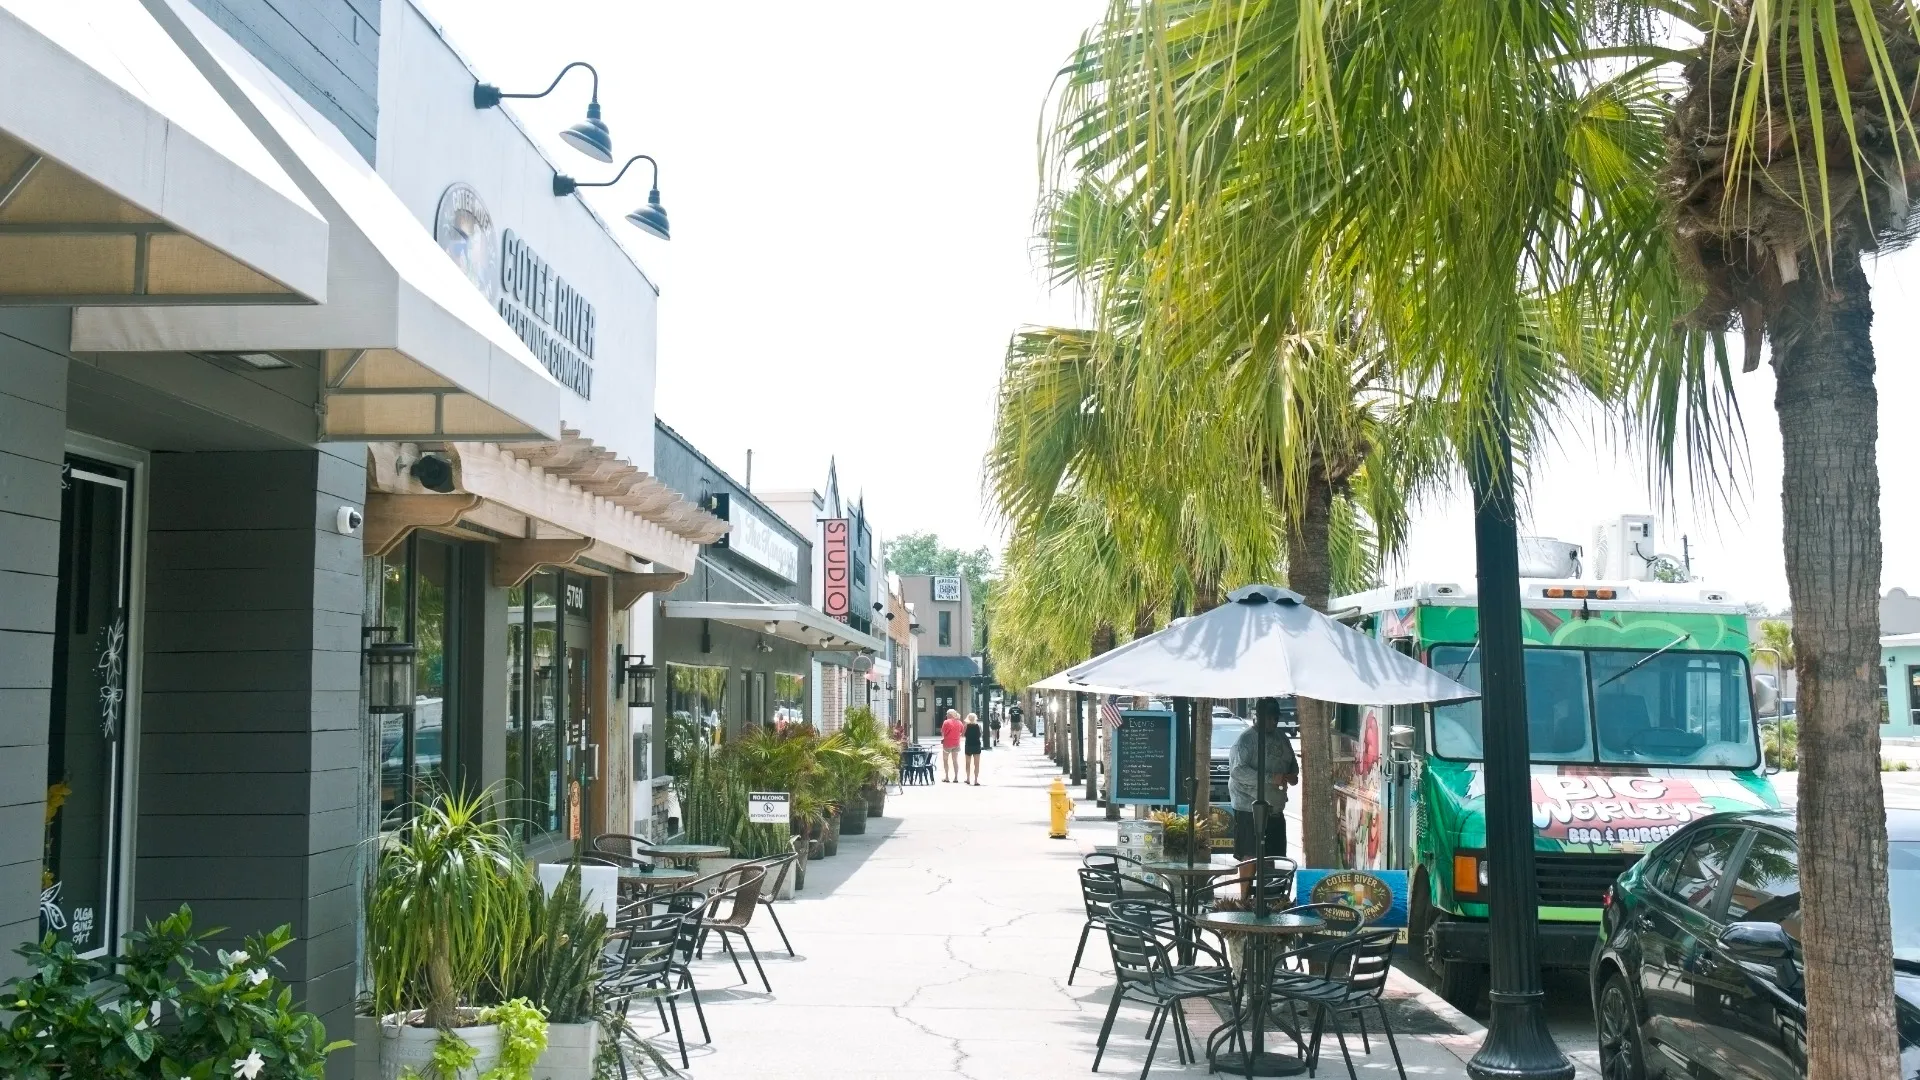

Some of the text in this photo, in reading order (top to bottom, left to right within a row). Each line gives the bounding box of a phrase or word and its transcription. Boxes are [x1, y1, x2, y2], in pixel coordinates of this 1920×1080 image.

[501, 227, 597, 361] COTEE RIVER
[549, 338, 594, 402] COMPANY
[827, 522, 847, 611] STUDIO
[566, 584, 583, 610] 5760
[1535, 775, 1669, 800] BIG
[1568, 827, 1602, 844] BBQ
[1326, 874, 1378, 888] COTEE RIVER
[73, 907, 94, 921] OLGA
